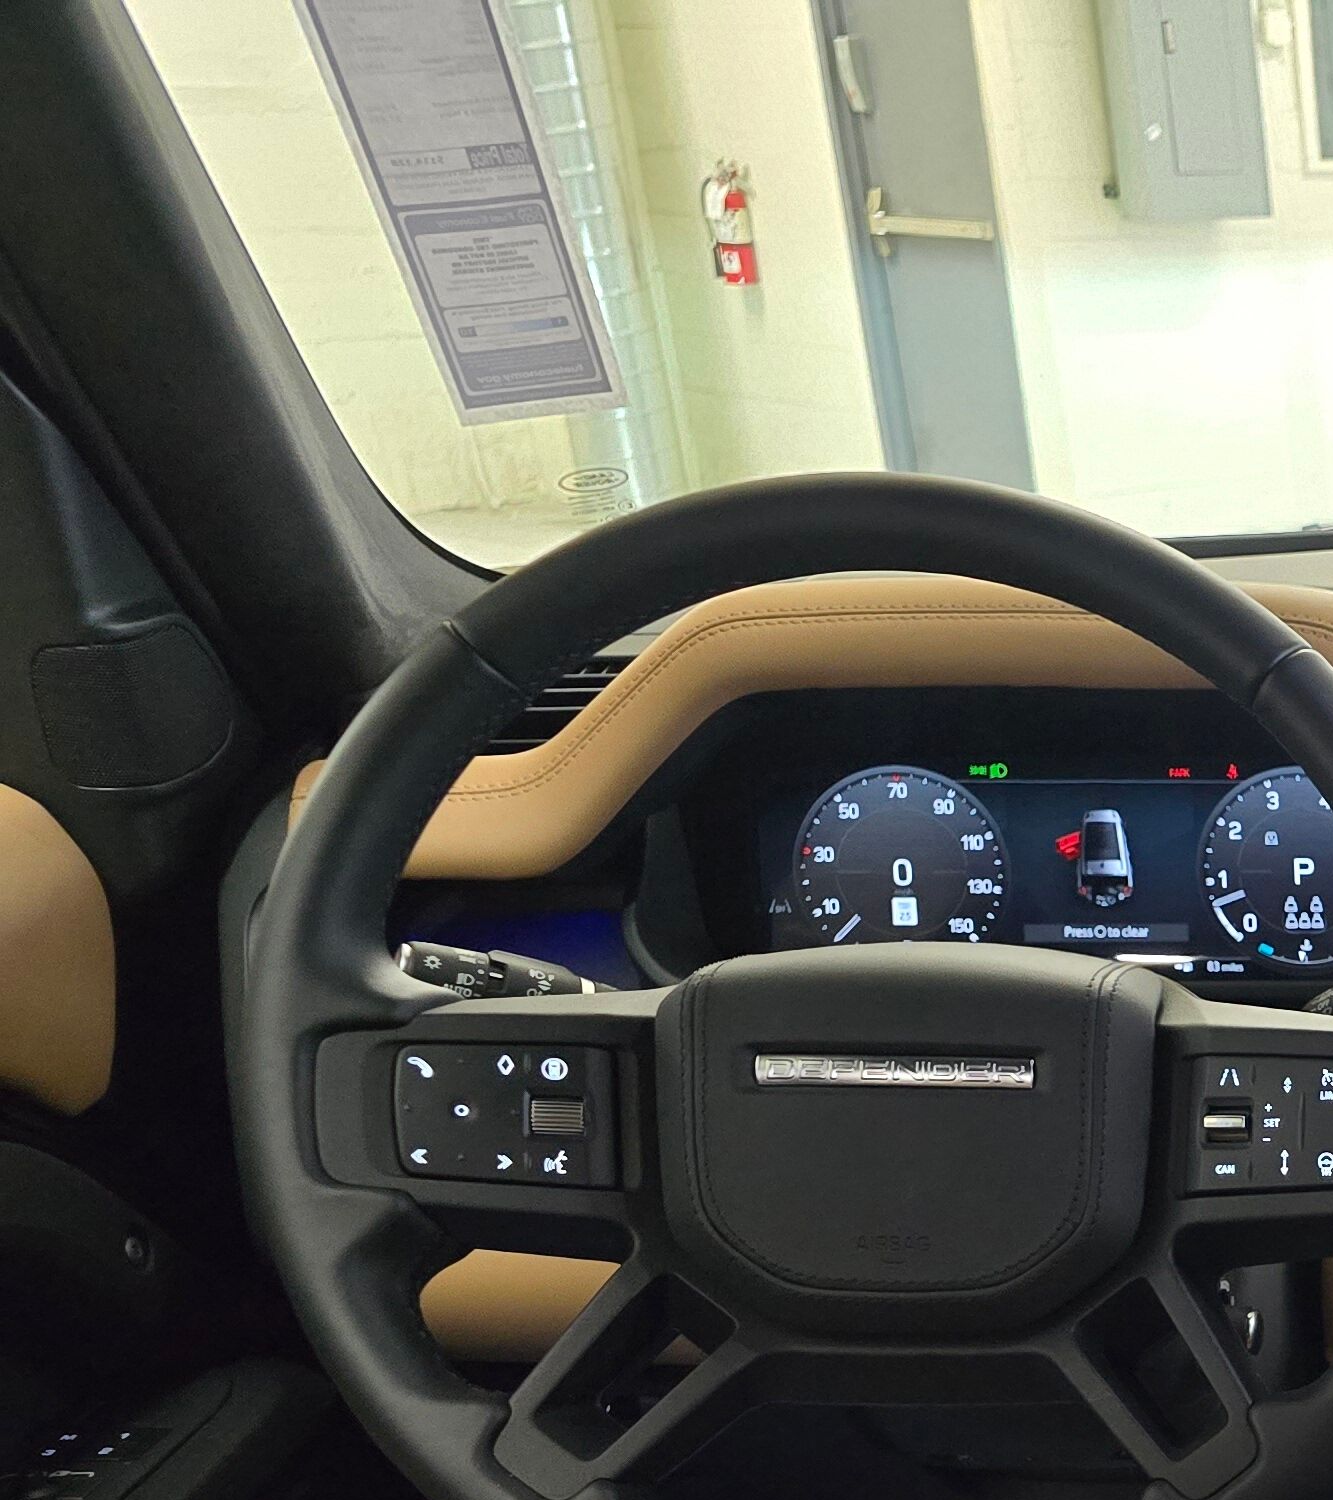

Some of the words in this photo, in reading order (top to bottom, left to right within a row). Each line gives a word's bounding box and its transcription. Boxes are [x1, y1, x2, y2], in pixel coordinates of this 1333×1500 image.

[887, 782, 908, 799] 70
[933, 798, 955, 815] 90
[1265, 791, 1280, 811] 3
[838, 803, 860, 820] 50
[1228, 821, 1243, 840] 2
[960, 834, 985, 851] 110
[813, 846, 835, 863] 30
[892, 858, 913, 887] 0
[1217, 869, 1229, 889] 1
[1292, 857, 1315, 886] P
[967, 879, 993, 895] 130
[821, 898, 840, 915] 10
[948, 918, 974, 934] 150
[1063, 925, 1094, 938] Press
[1107, 926, 1121, 938] to
[1242, 913, 1258, 933] 0
[765, 1057, 1027, 1084] DEFENDER
[1263, 1118, 1281, 1128] SET
